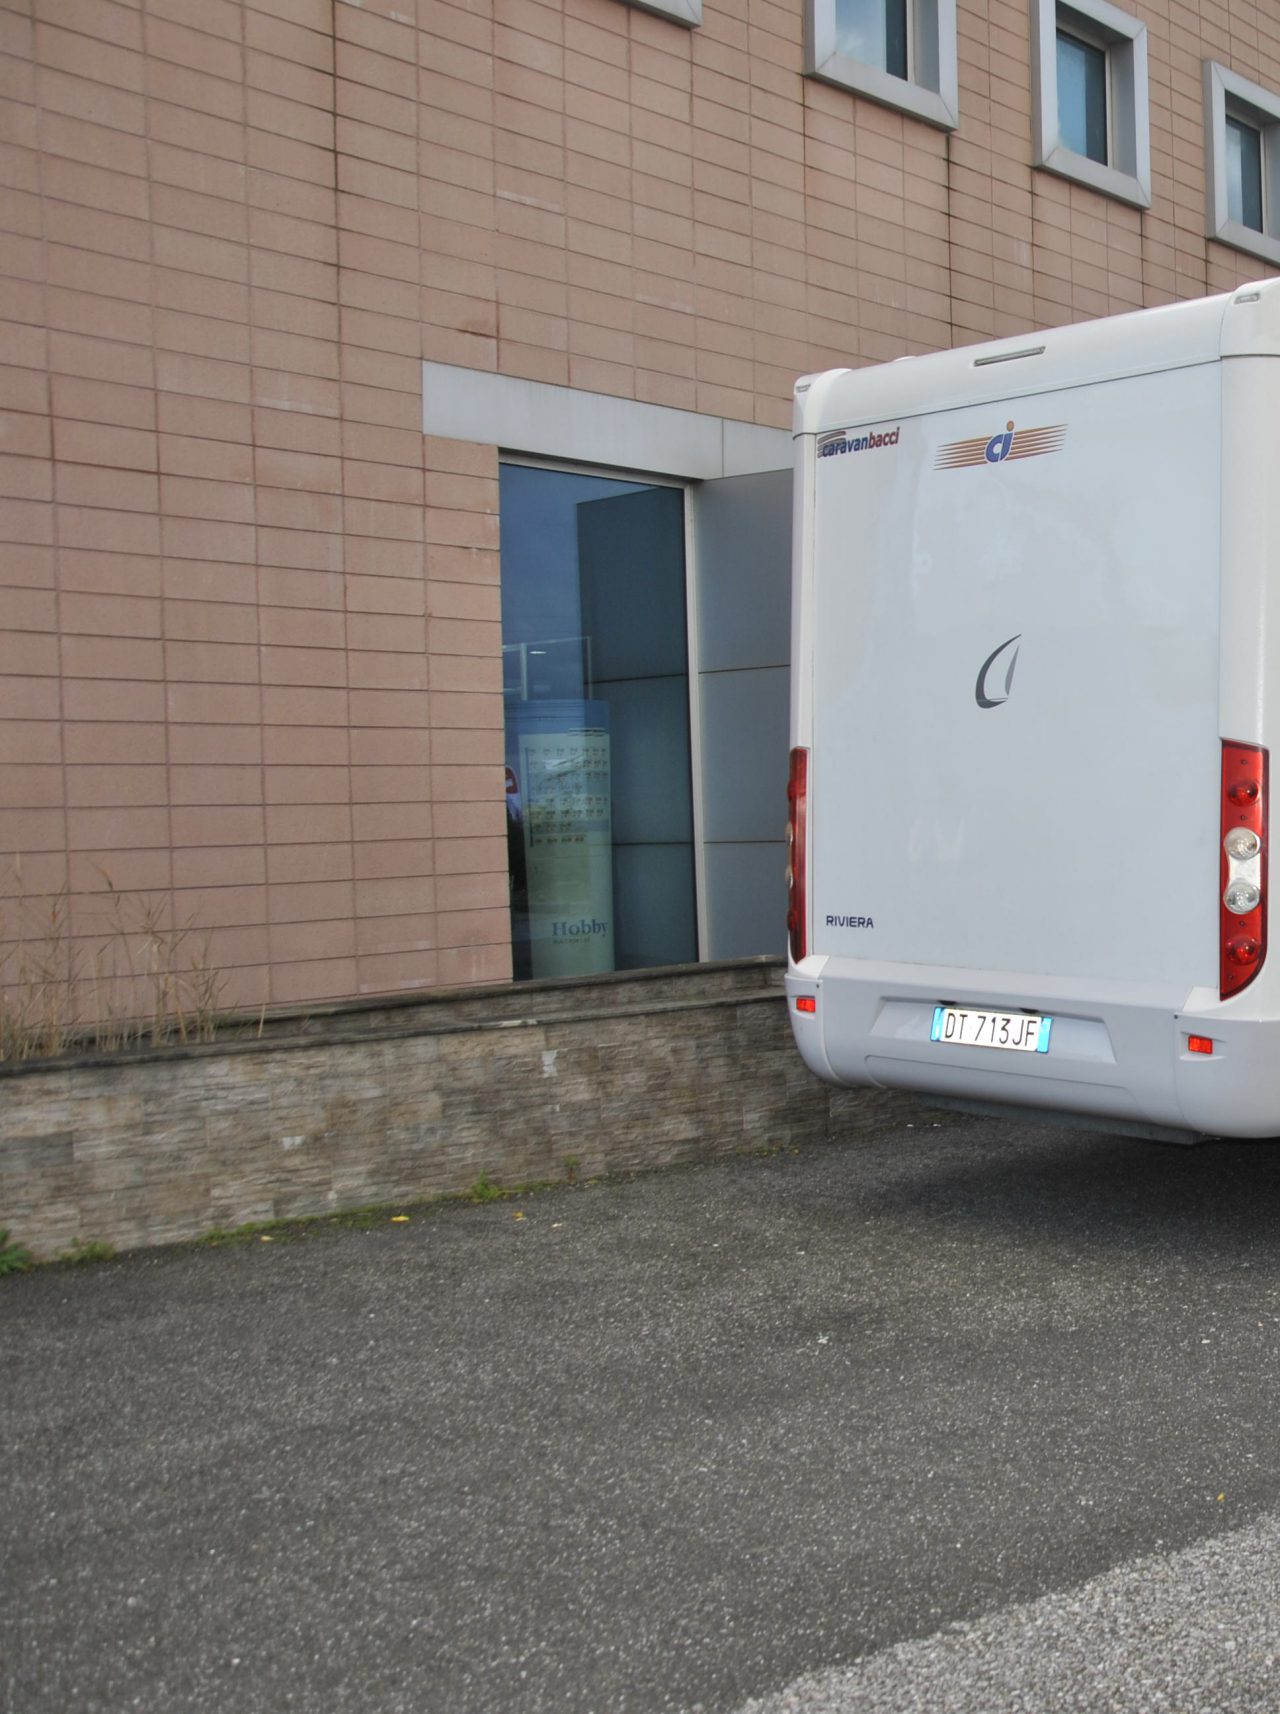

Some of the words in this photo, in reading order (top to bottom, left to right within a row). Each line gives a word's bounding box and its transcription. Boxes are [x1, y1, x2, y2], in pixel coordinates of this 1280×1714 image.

[822, 426, 900, 458] caravanbacci
[551, 918, 609, 938] Hobby
[826, 915, 874, 928] RIVIERA
[944, 1012, 968, 1040] DT
